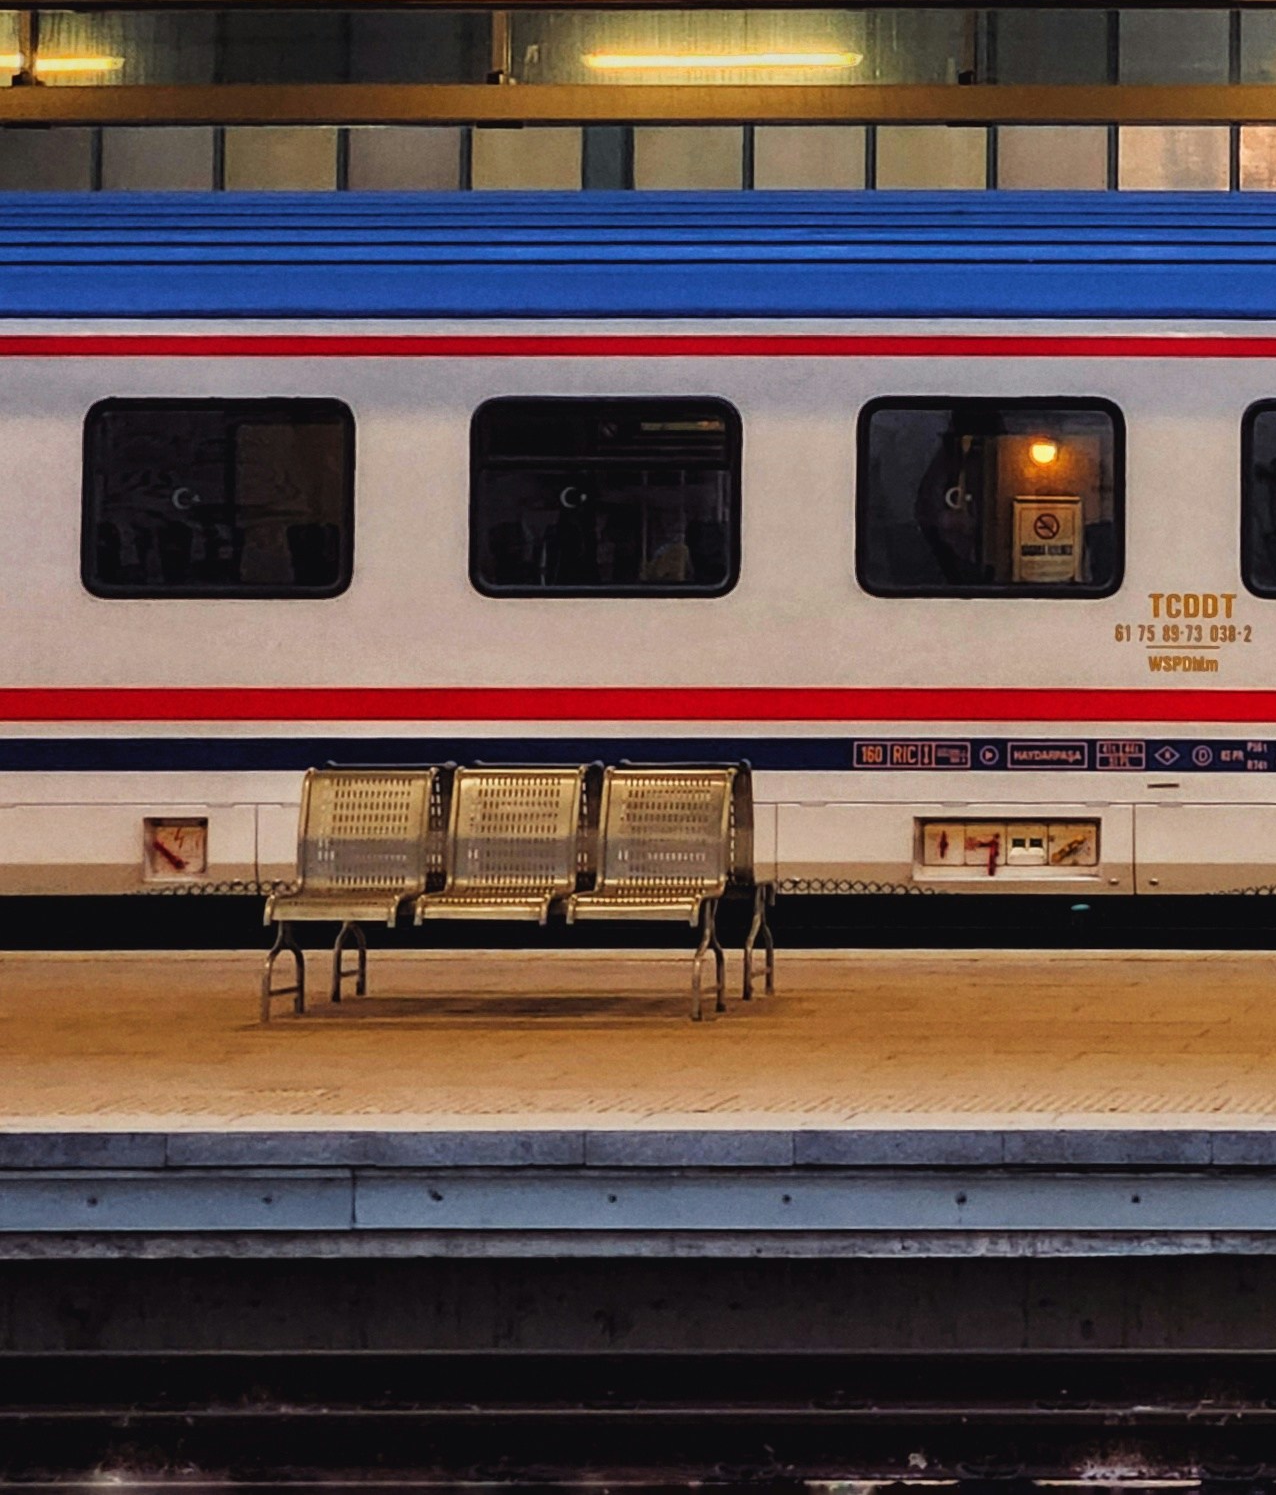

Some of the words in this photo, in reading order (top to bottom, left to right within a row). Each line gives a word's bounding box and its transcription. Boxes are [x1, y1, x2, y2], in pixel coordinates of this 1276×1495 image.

[1148, 594, 1237, 619] TCDDT
[1114, 623, 1132, 643] 61
[1137, 624, 1156, 643] 75
[861, 745, 883, 763] 160
[893, 745, 917, 764] RIC
